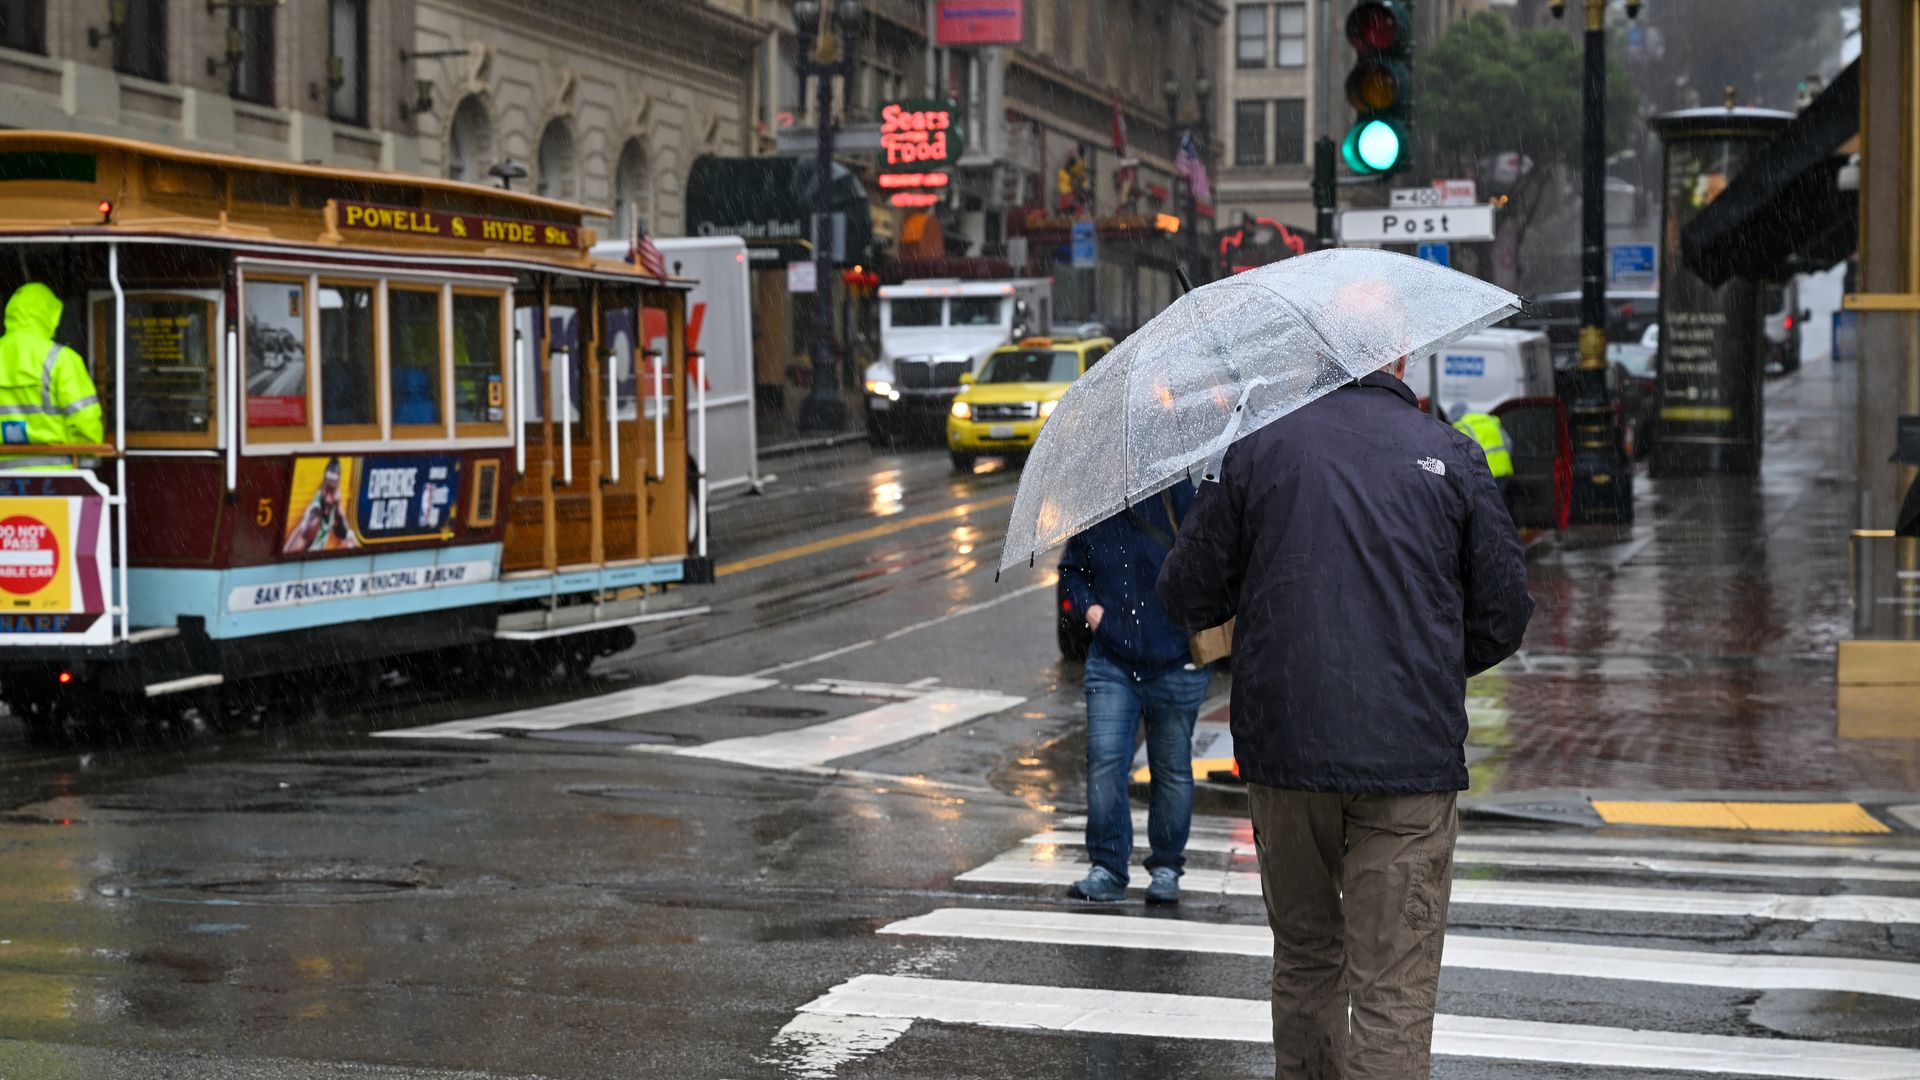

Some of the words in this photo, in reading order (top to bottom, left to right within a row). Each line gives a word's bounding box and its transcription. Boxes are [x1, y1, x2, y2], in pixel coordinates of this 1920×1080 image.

[881, 104, 949, 132] Sears
[881, 131, 947, 164] Food
[1409, 189, 1440, 205] 400
[345, 205, 440, 234] POWELL
[452, 216, 467, 237] &
[482, 220, 536, 243] HYDE
[1382, 214, 1450, 234] Post
[256, 498, 272, 527] 5
[3, 538, 39, 550] PASS
[18, 525, 47, 539] NOT
[29, 567, 54, 578] CAR
[254, 585, 282, 604] SAN
[284, 578, 354, 600] FRANCISCO
[360, 570, 417, 592] MUNICIPAL
[424, 566, 468, 584] RAILWAY
